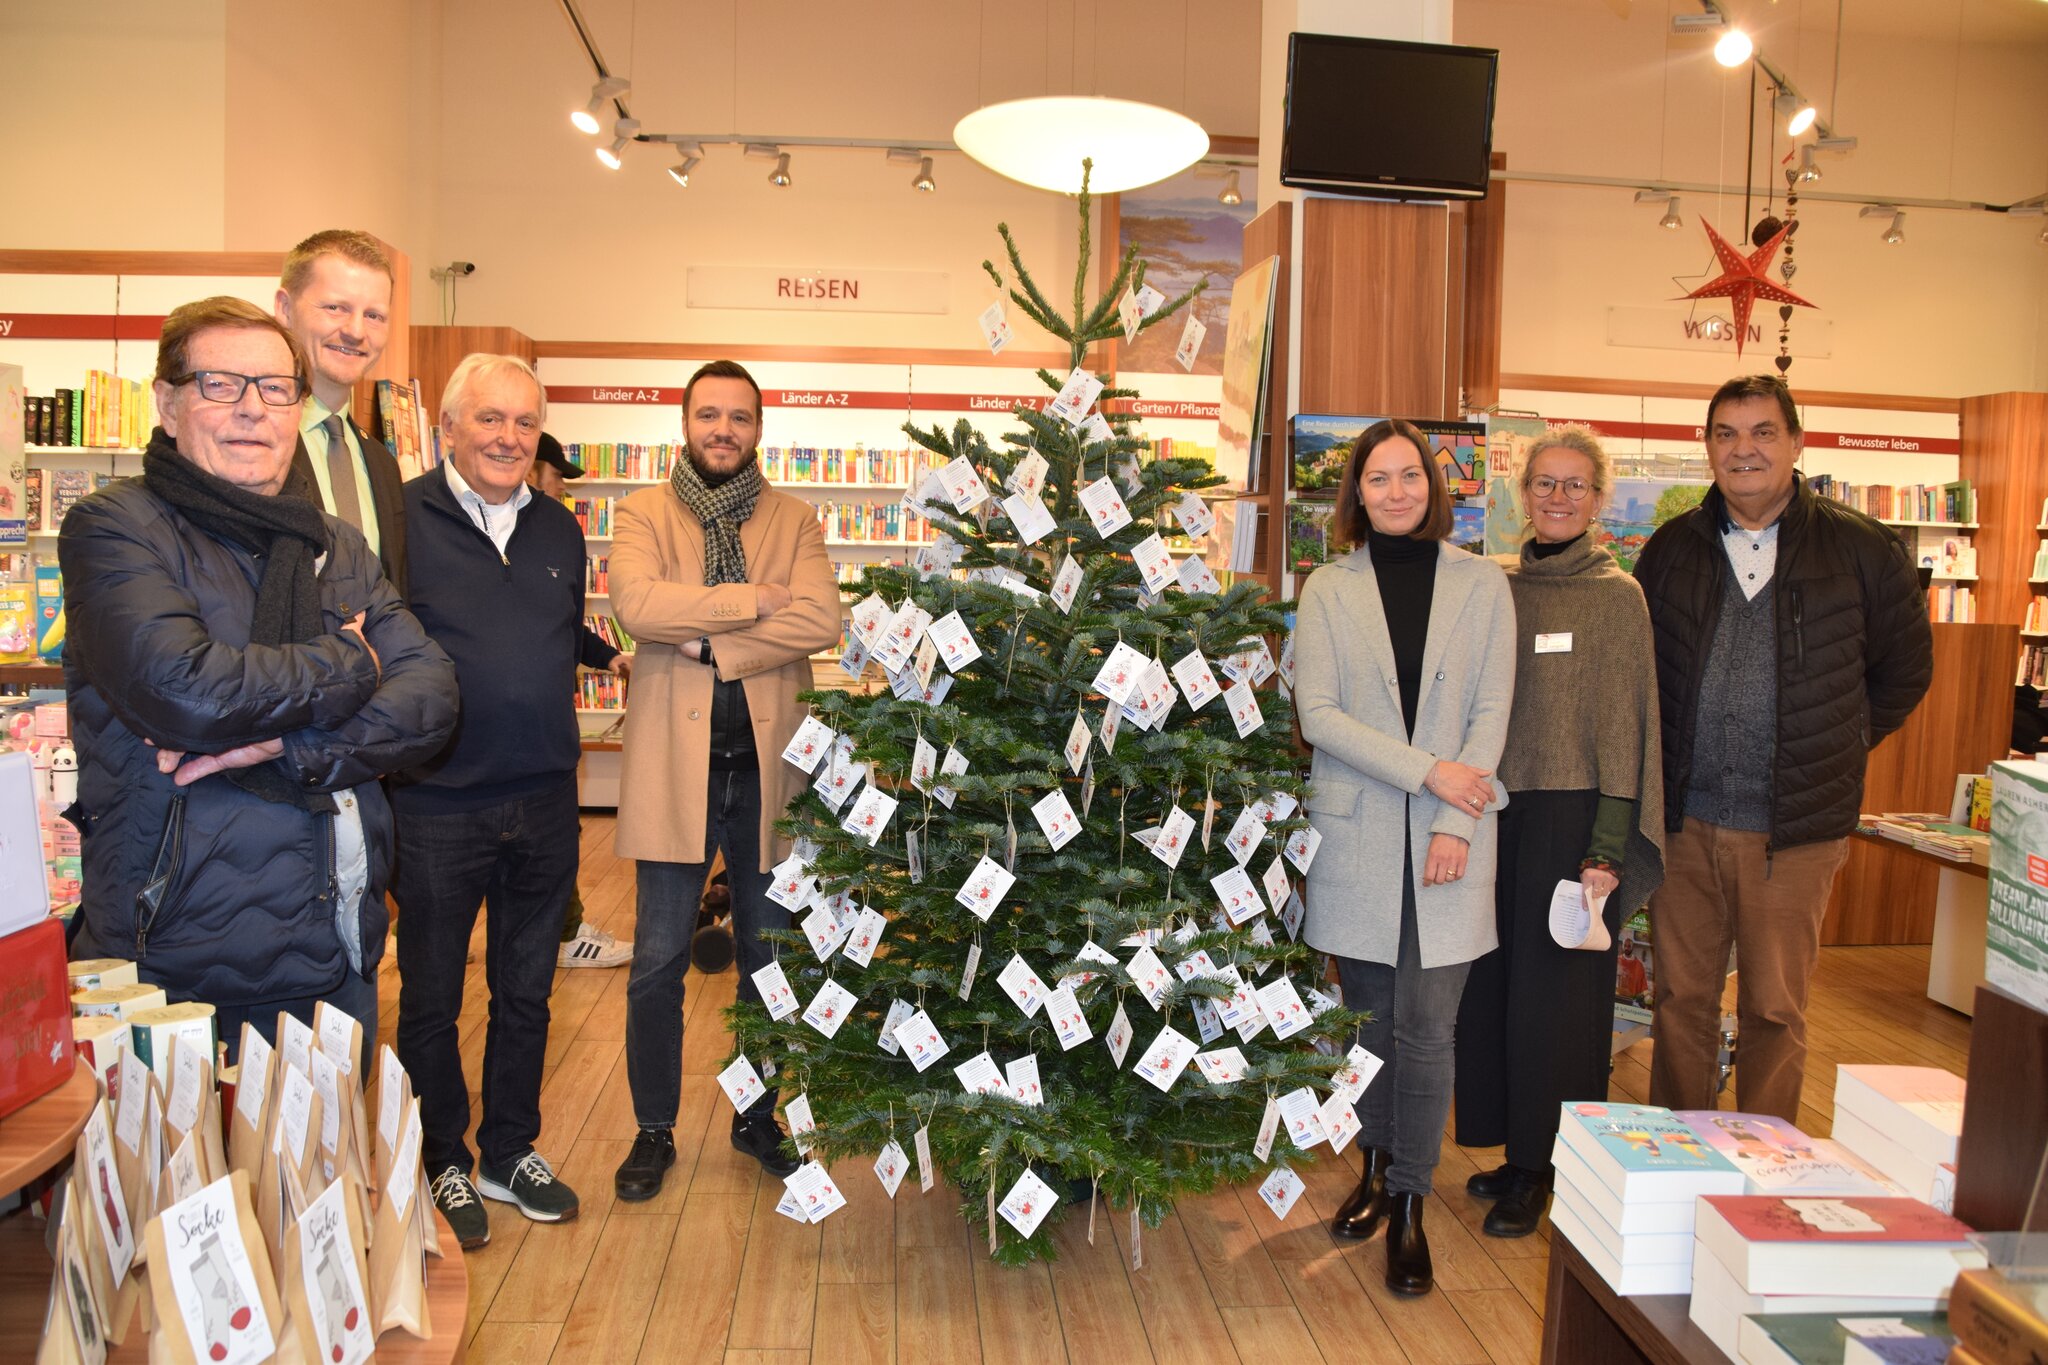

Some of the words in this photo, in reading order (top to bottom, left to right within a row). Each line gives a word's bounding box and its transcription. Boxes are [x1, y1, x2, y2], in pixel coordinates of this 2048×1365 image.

[778, 278, 858, 299] REISEN
[1684, 320, 1761, 343] WISSN
[592, 389, 634, 400] Länder
[636, 390, 660, 401] A-Z
[781, 392, 822, 404] Länder
[825, 394, 849, 405] A-Z
[970, 397, 1011, 409] Länder
[1013, 399, 1036, 410] A-Z
[1132, 402, 1172, 414] Garten
[1838, 435, 1889, 448] Bewusster
[1891, 438, 1919, 450] leben
[178, 1203, 225, 1248] Socke
[309, 1204, 340, 1252] Socke
